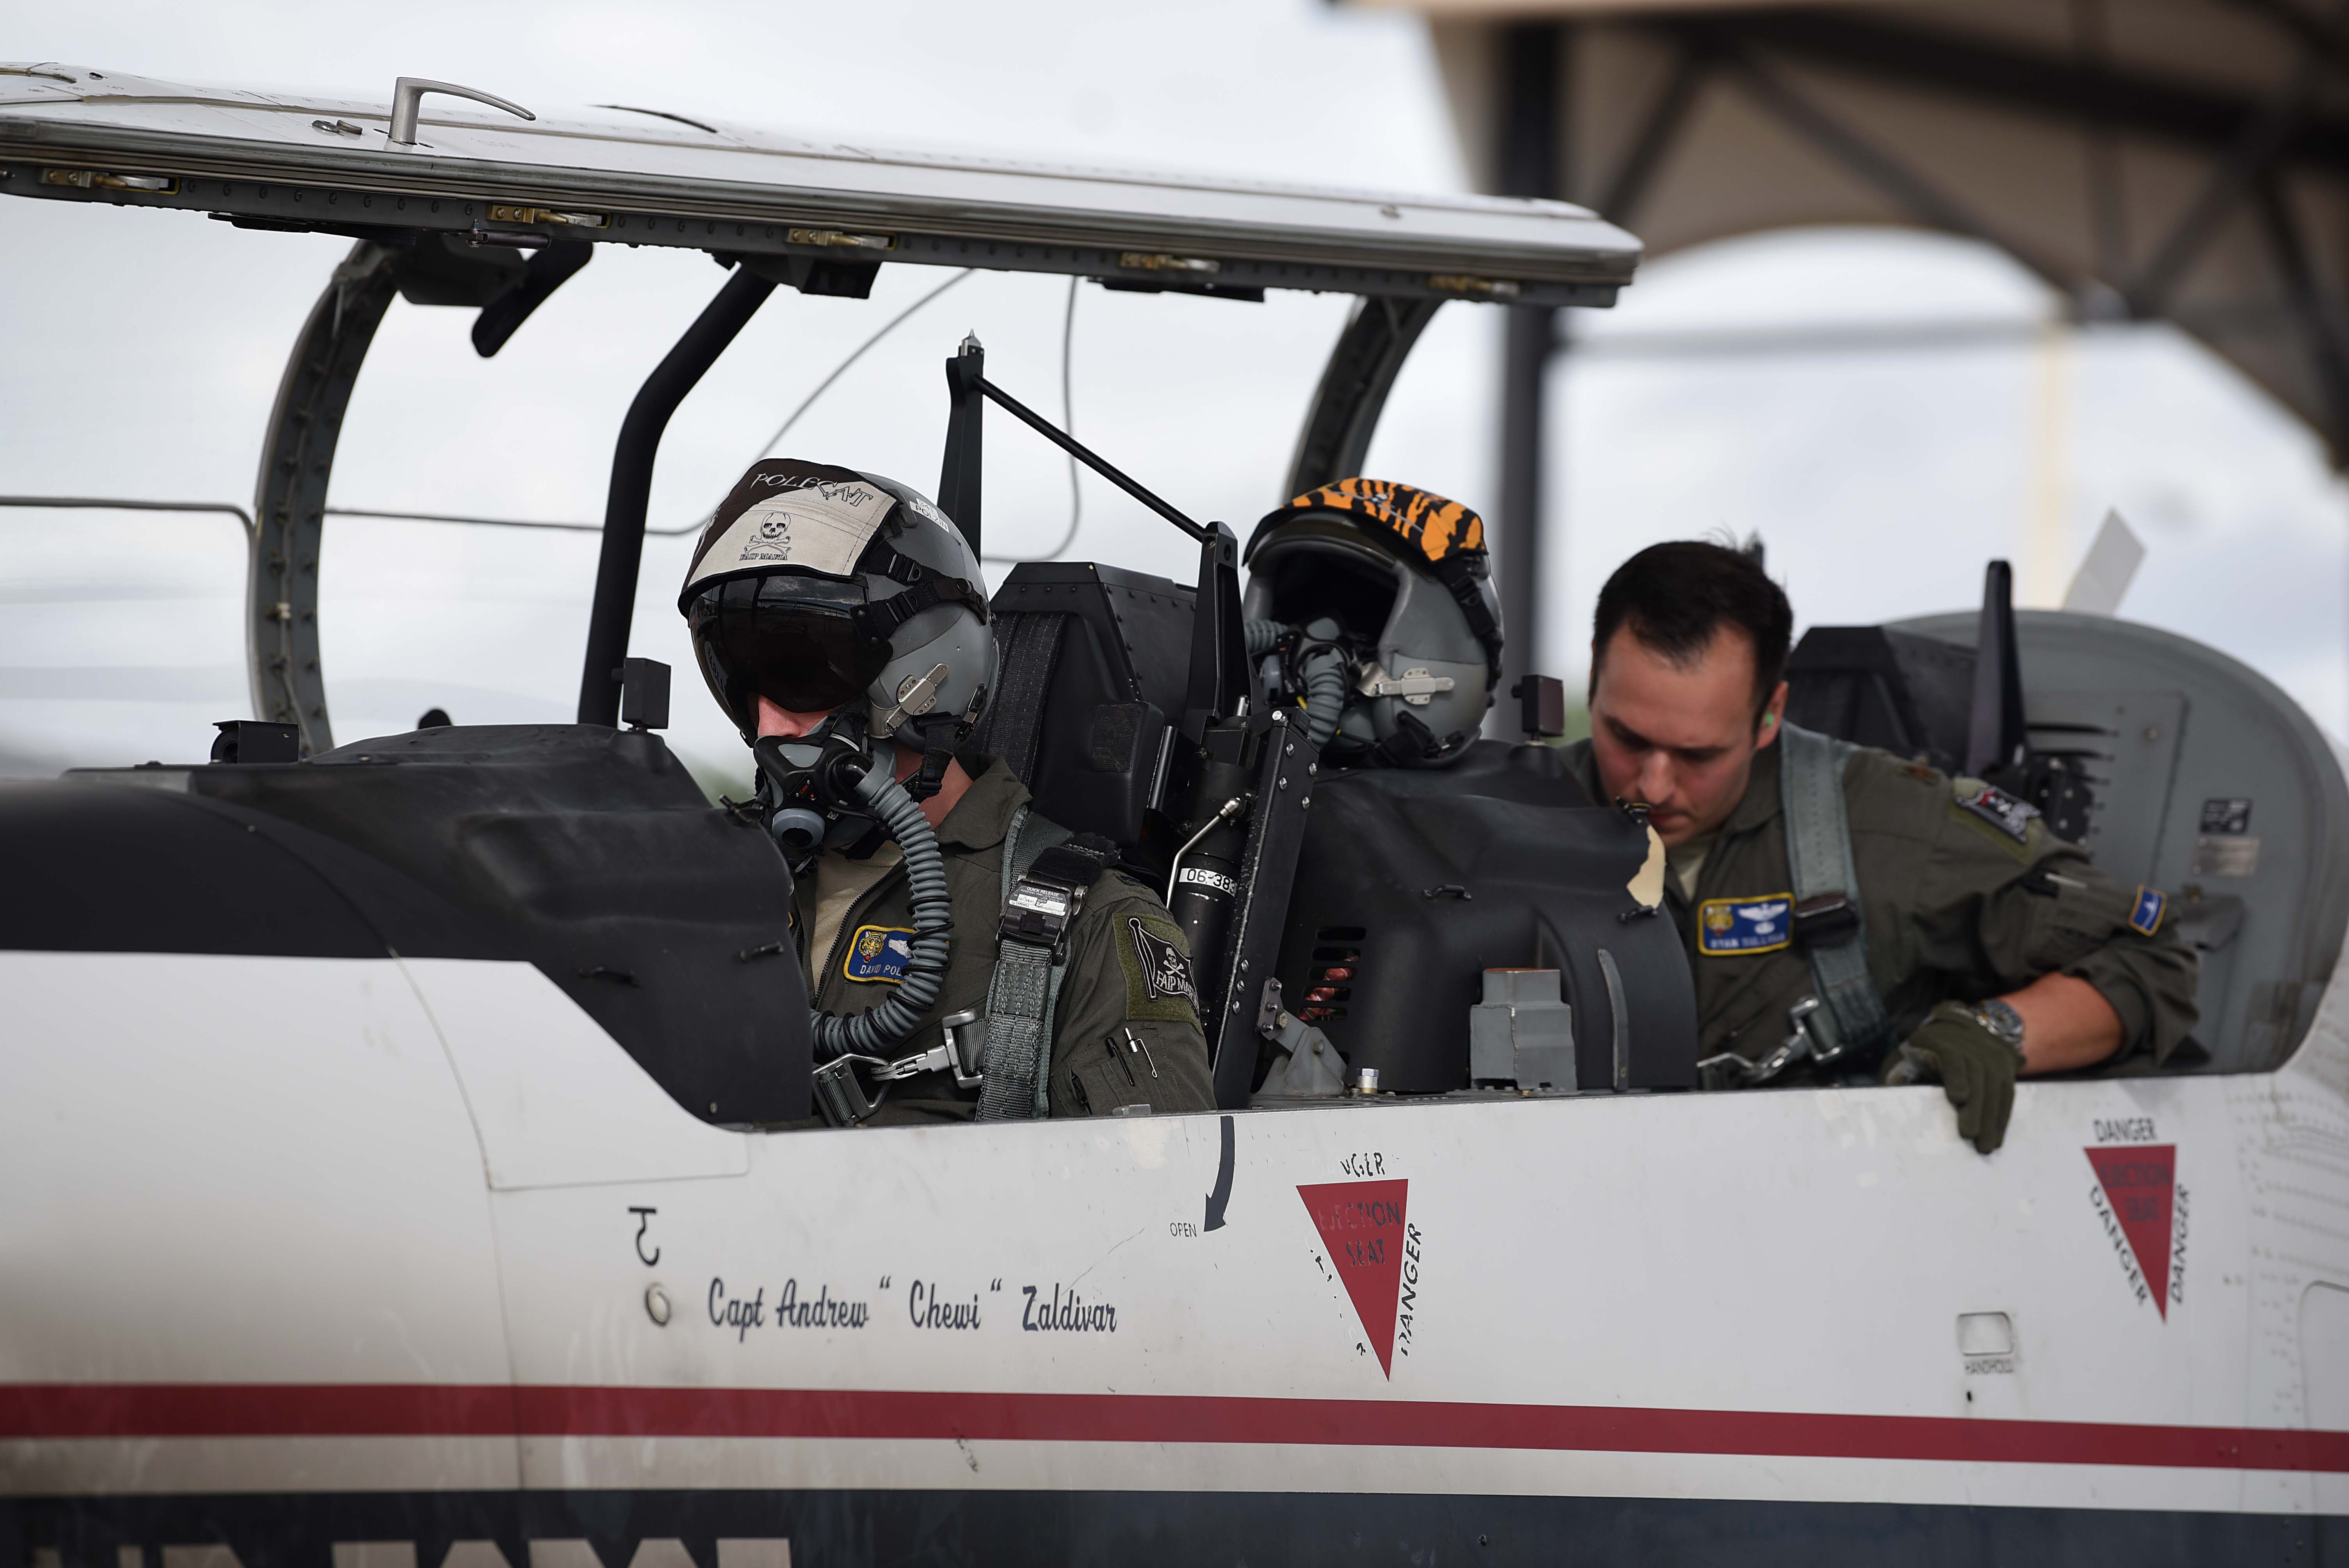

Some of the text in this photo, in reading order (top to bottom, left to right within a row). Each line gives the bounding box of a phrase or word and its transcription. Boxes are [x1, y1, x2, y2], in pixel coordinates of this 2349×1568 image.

[750, 473, 873, 507] POLECAT
[915, 504, 948, 530] POLZIN
[1040, 889, 1059, 898] RELEASE
[860, 964, 901, 976] DAVID POL
[1156, 970, 1176, 991] FAIP
[2094, 1119, 2158, 1142] DANGER
[1170, 1222, 1197, 1237] OPEN
[1346, 1238, 1385, 1267] SEAT
[708, 1278, 766, 1343] Capt
[775, 1278, 870, 1328] Andrew
[1021, 1283, 1117, 1333] Zaldivar
